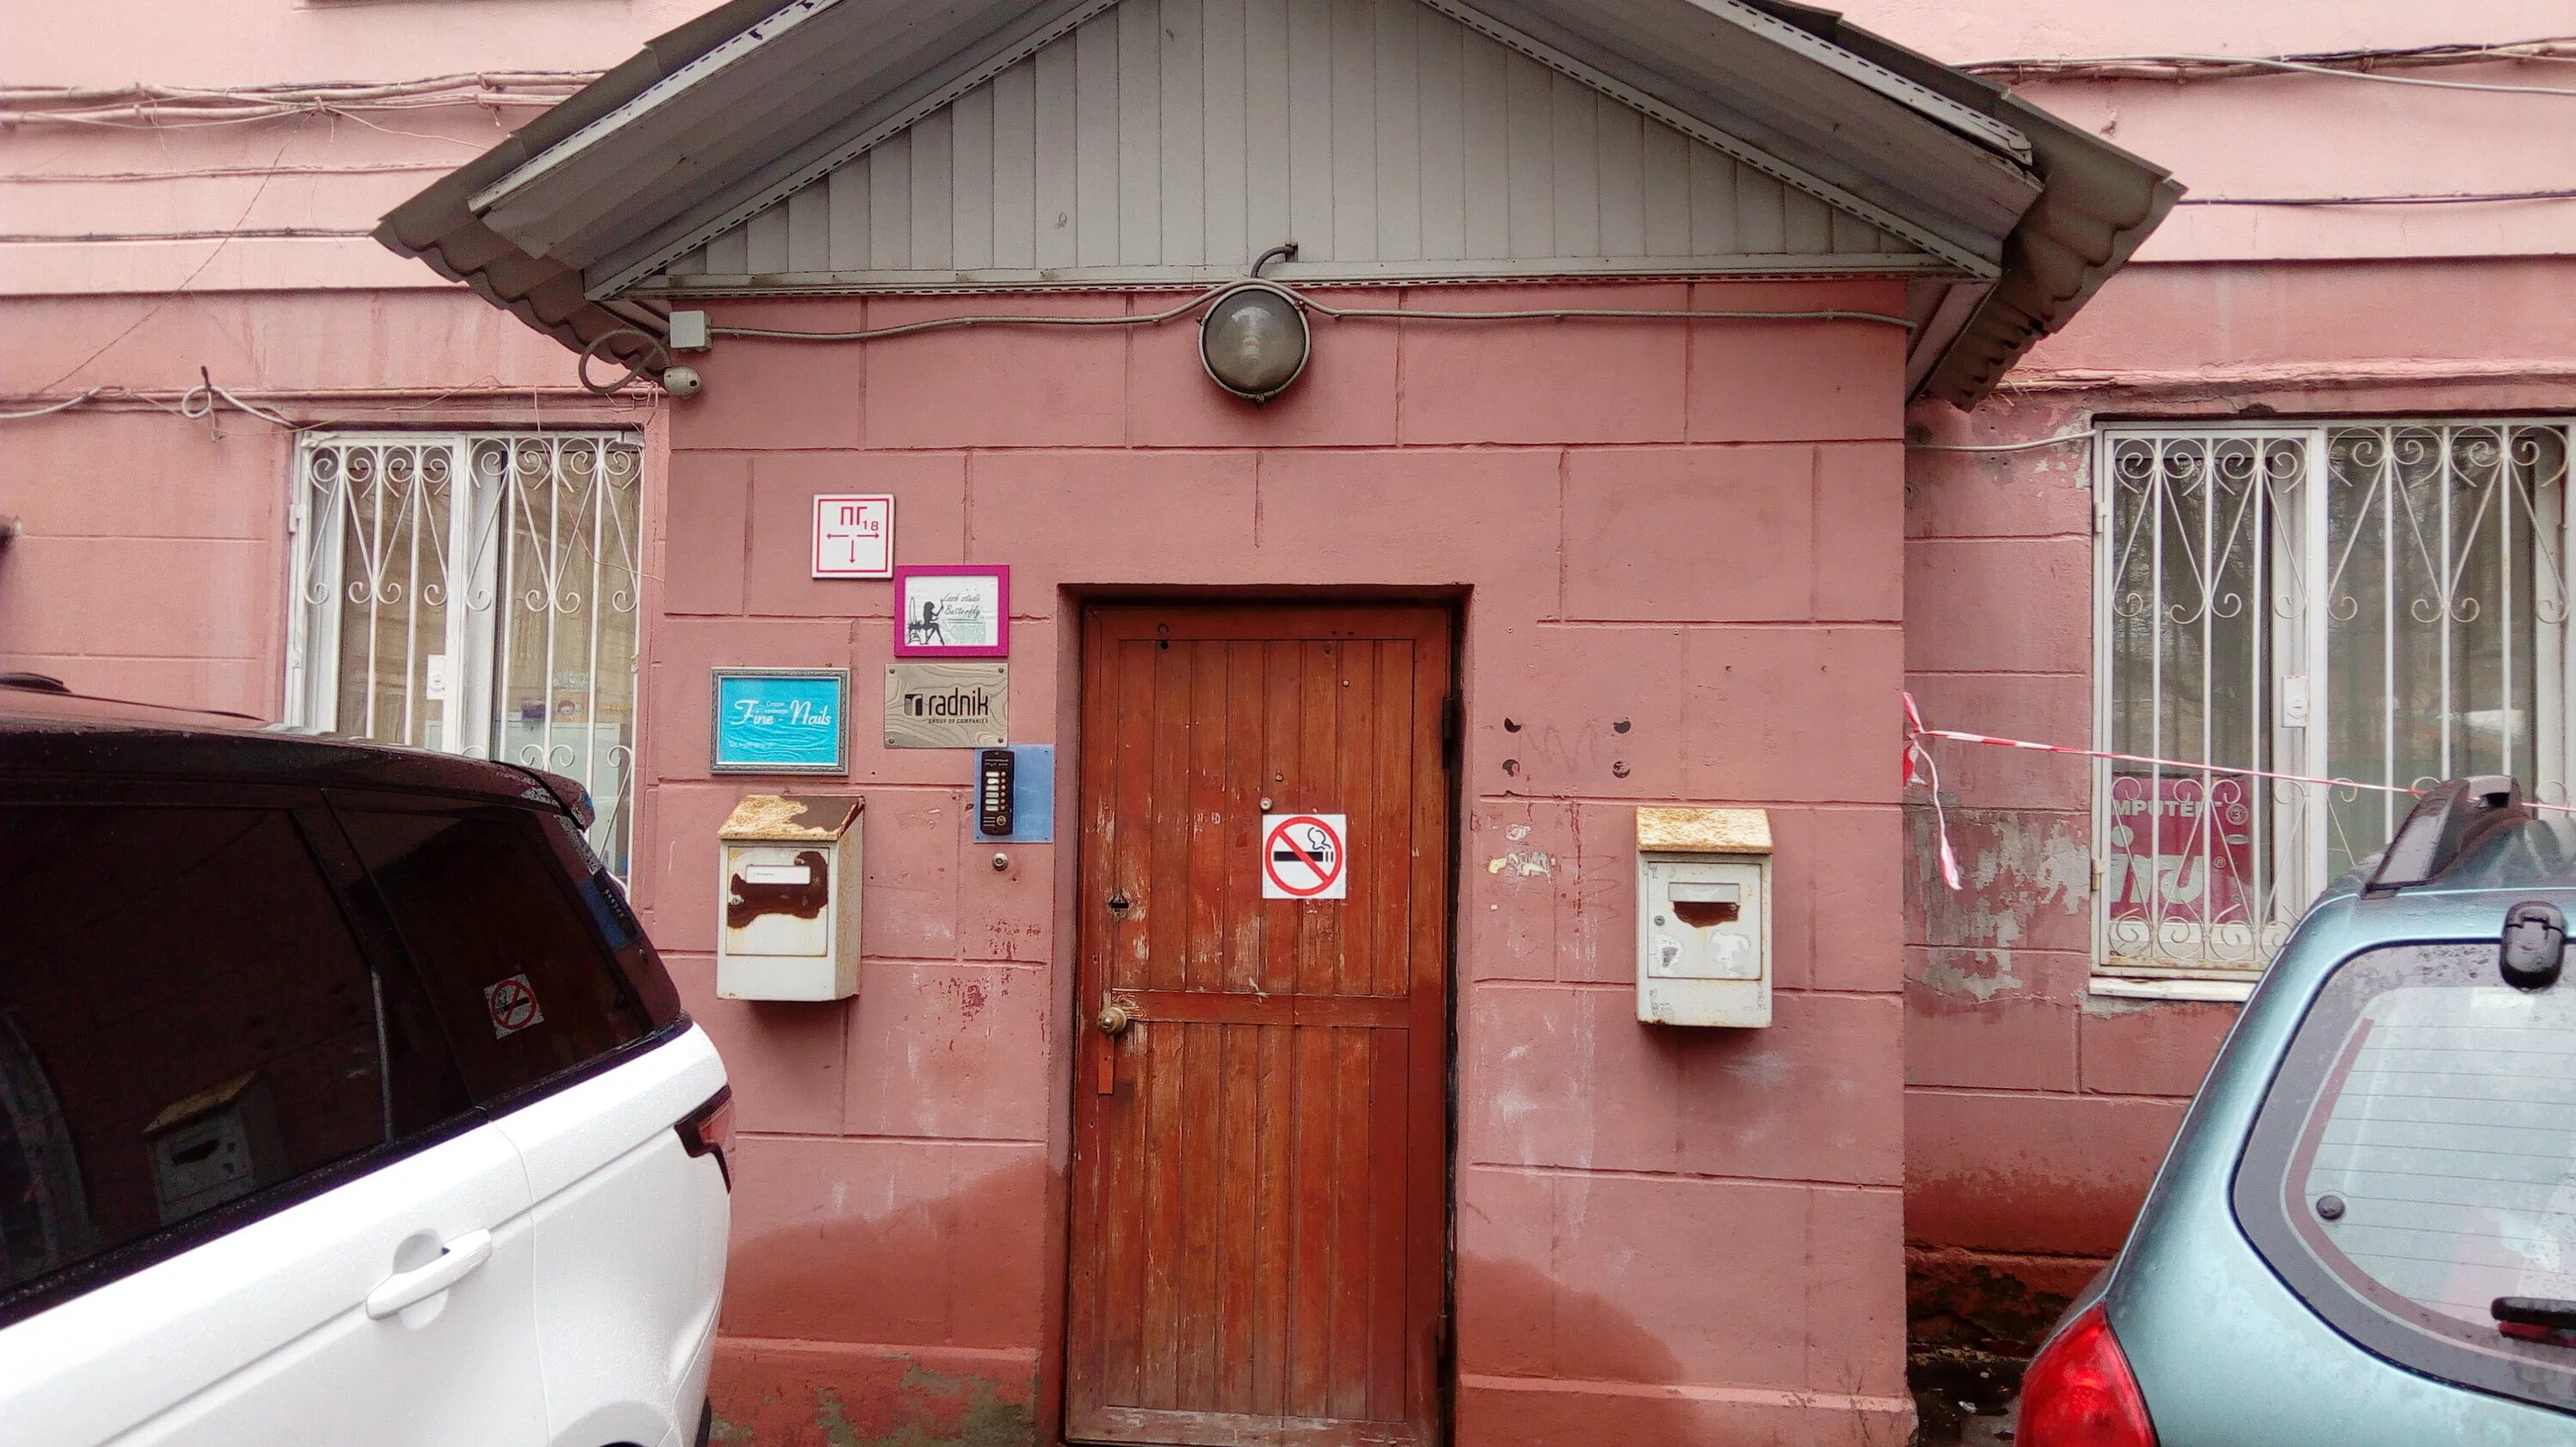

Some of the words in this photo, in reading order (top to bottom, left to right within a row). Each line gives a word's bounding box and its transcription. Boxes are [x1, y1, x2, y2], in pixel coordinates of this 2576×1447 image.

[841, 507, 867, 526] ПГ
[862, 520, 879, 532] 18
[945, 604, 981, 619] Butterfly
[928, 686, 989, 716] radnik
[730, 699, 775, 726] Fine
[789, 699, 832, 726] Nails
